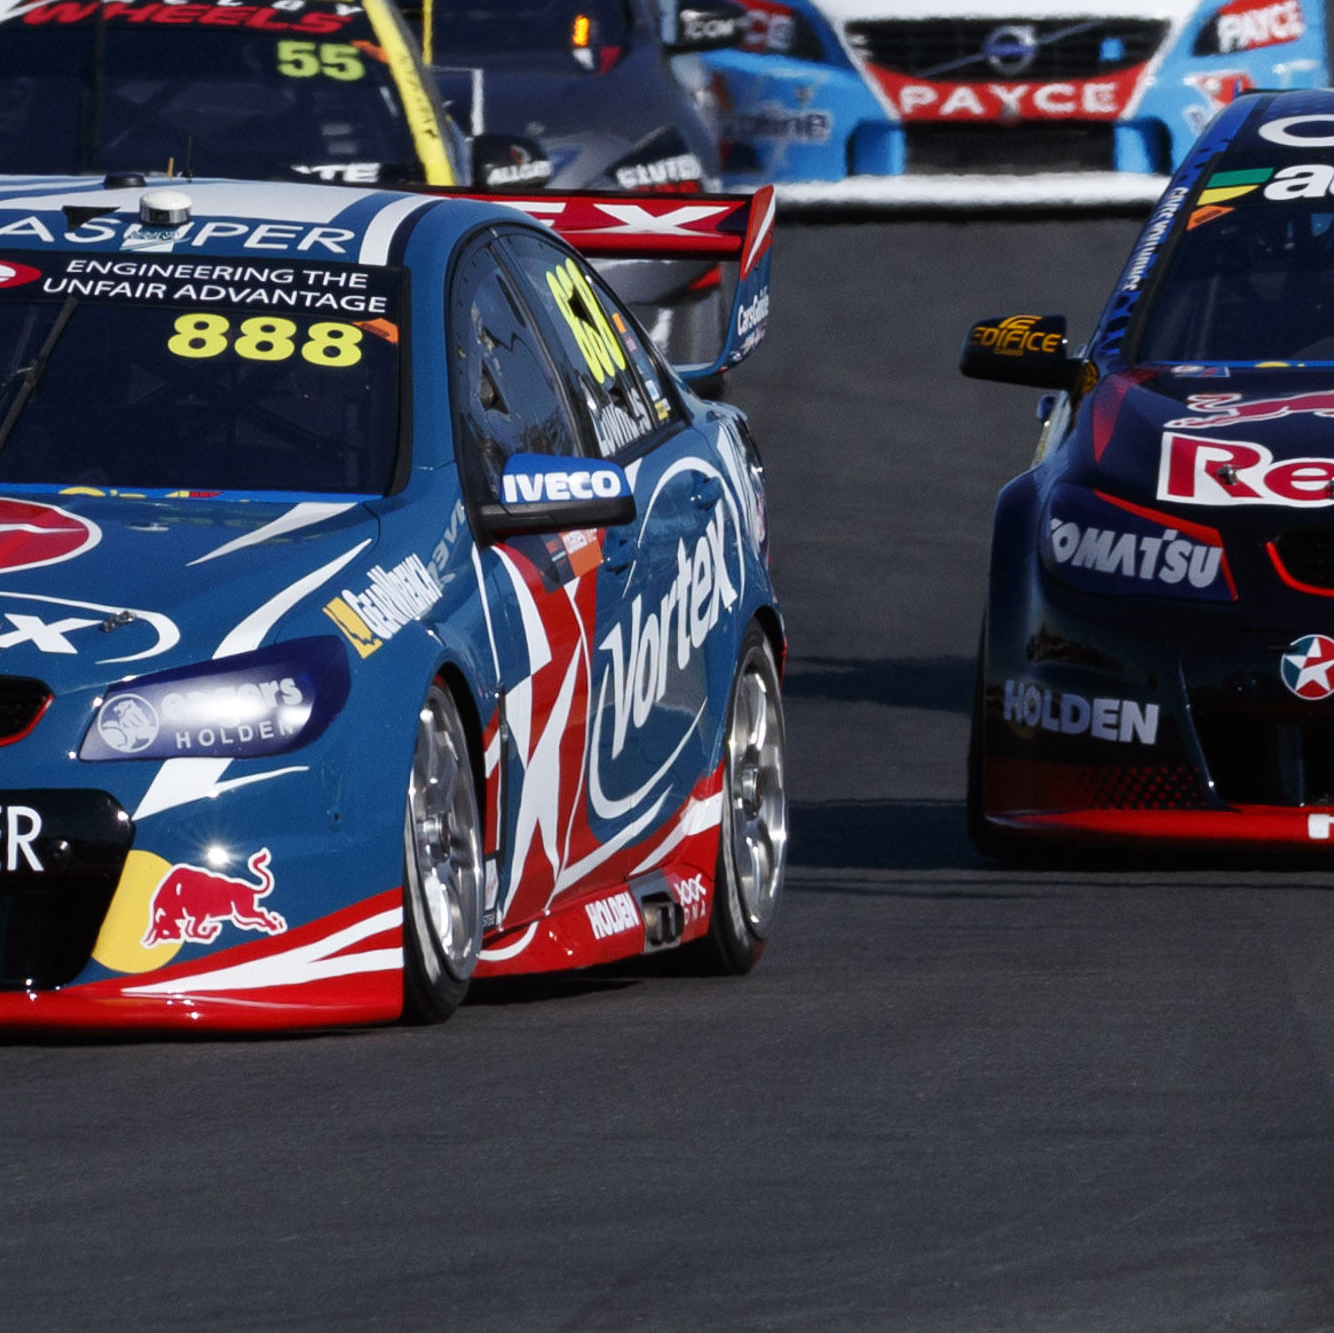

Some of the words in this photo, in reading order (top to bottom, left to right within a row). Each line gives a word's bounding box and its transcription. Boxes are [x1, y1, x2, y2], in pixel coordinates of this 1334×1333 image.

[276, 40, 366, 82] 55
[898, 80, 1121, 116] PAYCE
[66, 259, 297, 285] ENGINEERING
[303, 268, 370, 290] THE
[41, 277, 167, 301] UNFAIR
[173, 284, 389, 313] ADVANTAGE
[167, 312, 364, 367] 888
[968, 324, 1063, 353] EDIFICE
[501, 470, 622, 503] IVECO
[1048, 516, 1223, 589] OMATSU
[599, 500, 738, 759] Vortex
[1002, 678, 1160, 746] HOLDEN
[175, 719, 295, 750] HOLDEN
[584, 891, 641, 940] HOLDEN
